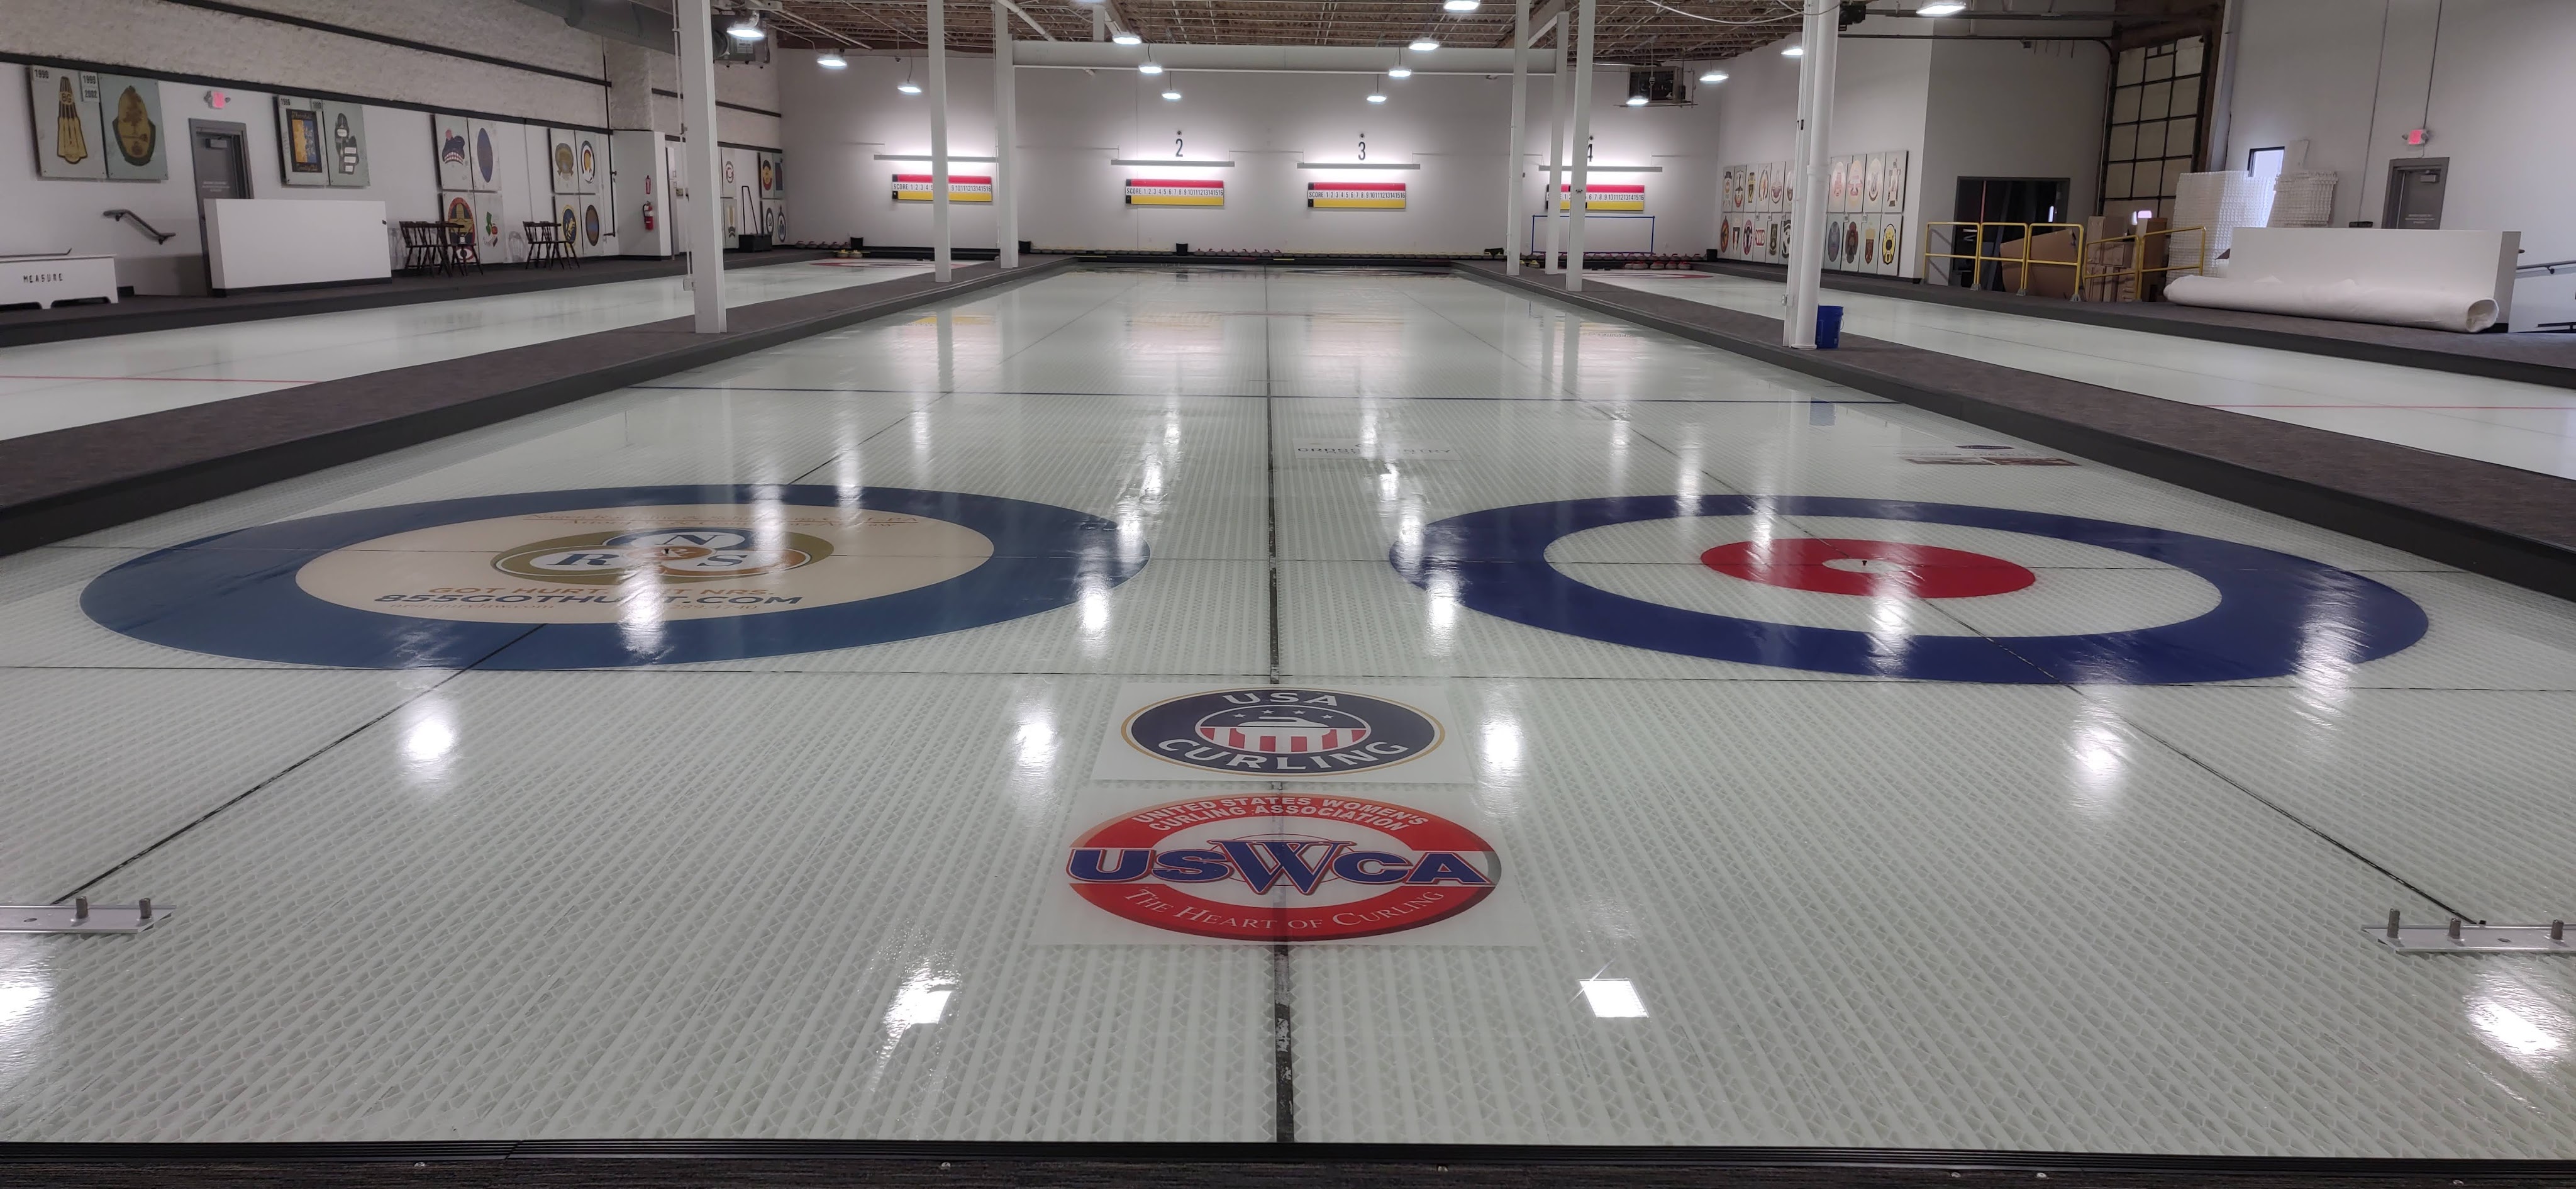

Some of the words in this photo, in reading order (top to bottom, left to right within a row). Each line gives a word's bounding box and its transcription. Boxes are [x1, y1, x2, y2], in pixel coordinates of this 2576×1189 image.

[1175, 138, 1183, 157] 2
[1358, 142, 1365, 160] 3
[23, 273, 63, 283] MEASURE
[654, 534, 723, 545] N
[546, 553, 620, 566] R
[696, 554, 748, 566] S
[374, 594, 803, 604] 855GOTHUT.COM
[1222, 692, 1338, 706] USA
[1158, 739, 1409, 770] CURLING
[1133, 801, 1217, 822] UNITED
[1222, 797, 1311, 807] STATES
[1322, 799, 1429, 826] WOMEN'S
[1149, 807, 1246, 831] CURLING
[1254, 805, 1409, 832] ASSOCIATION
[1067, 839, 1494, 896] USWCA
[1125, 888, 1174, 913] THE
[1173, 905, 1277, 929] HEART
[1332, 891, 1445, 927] CURLING
